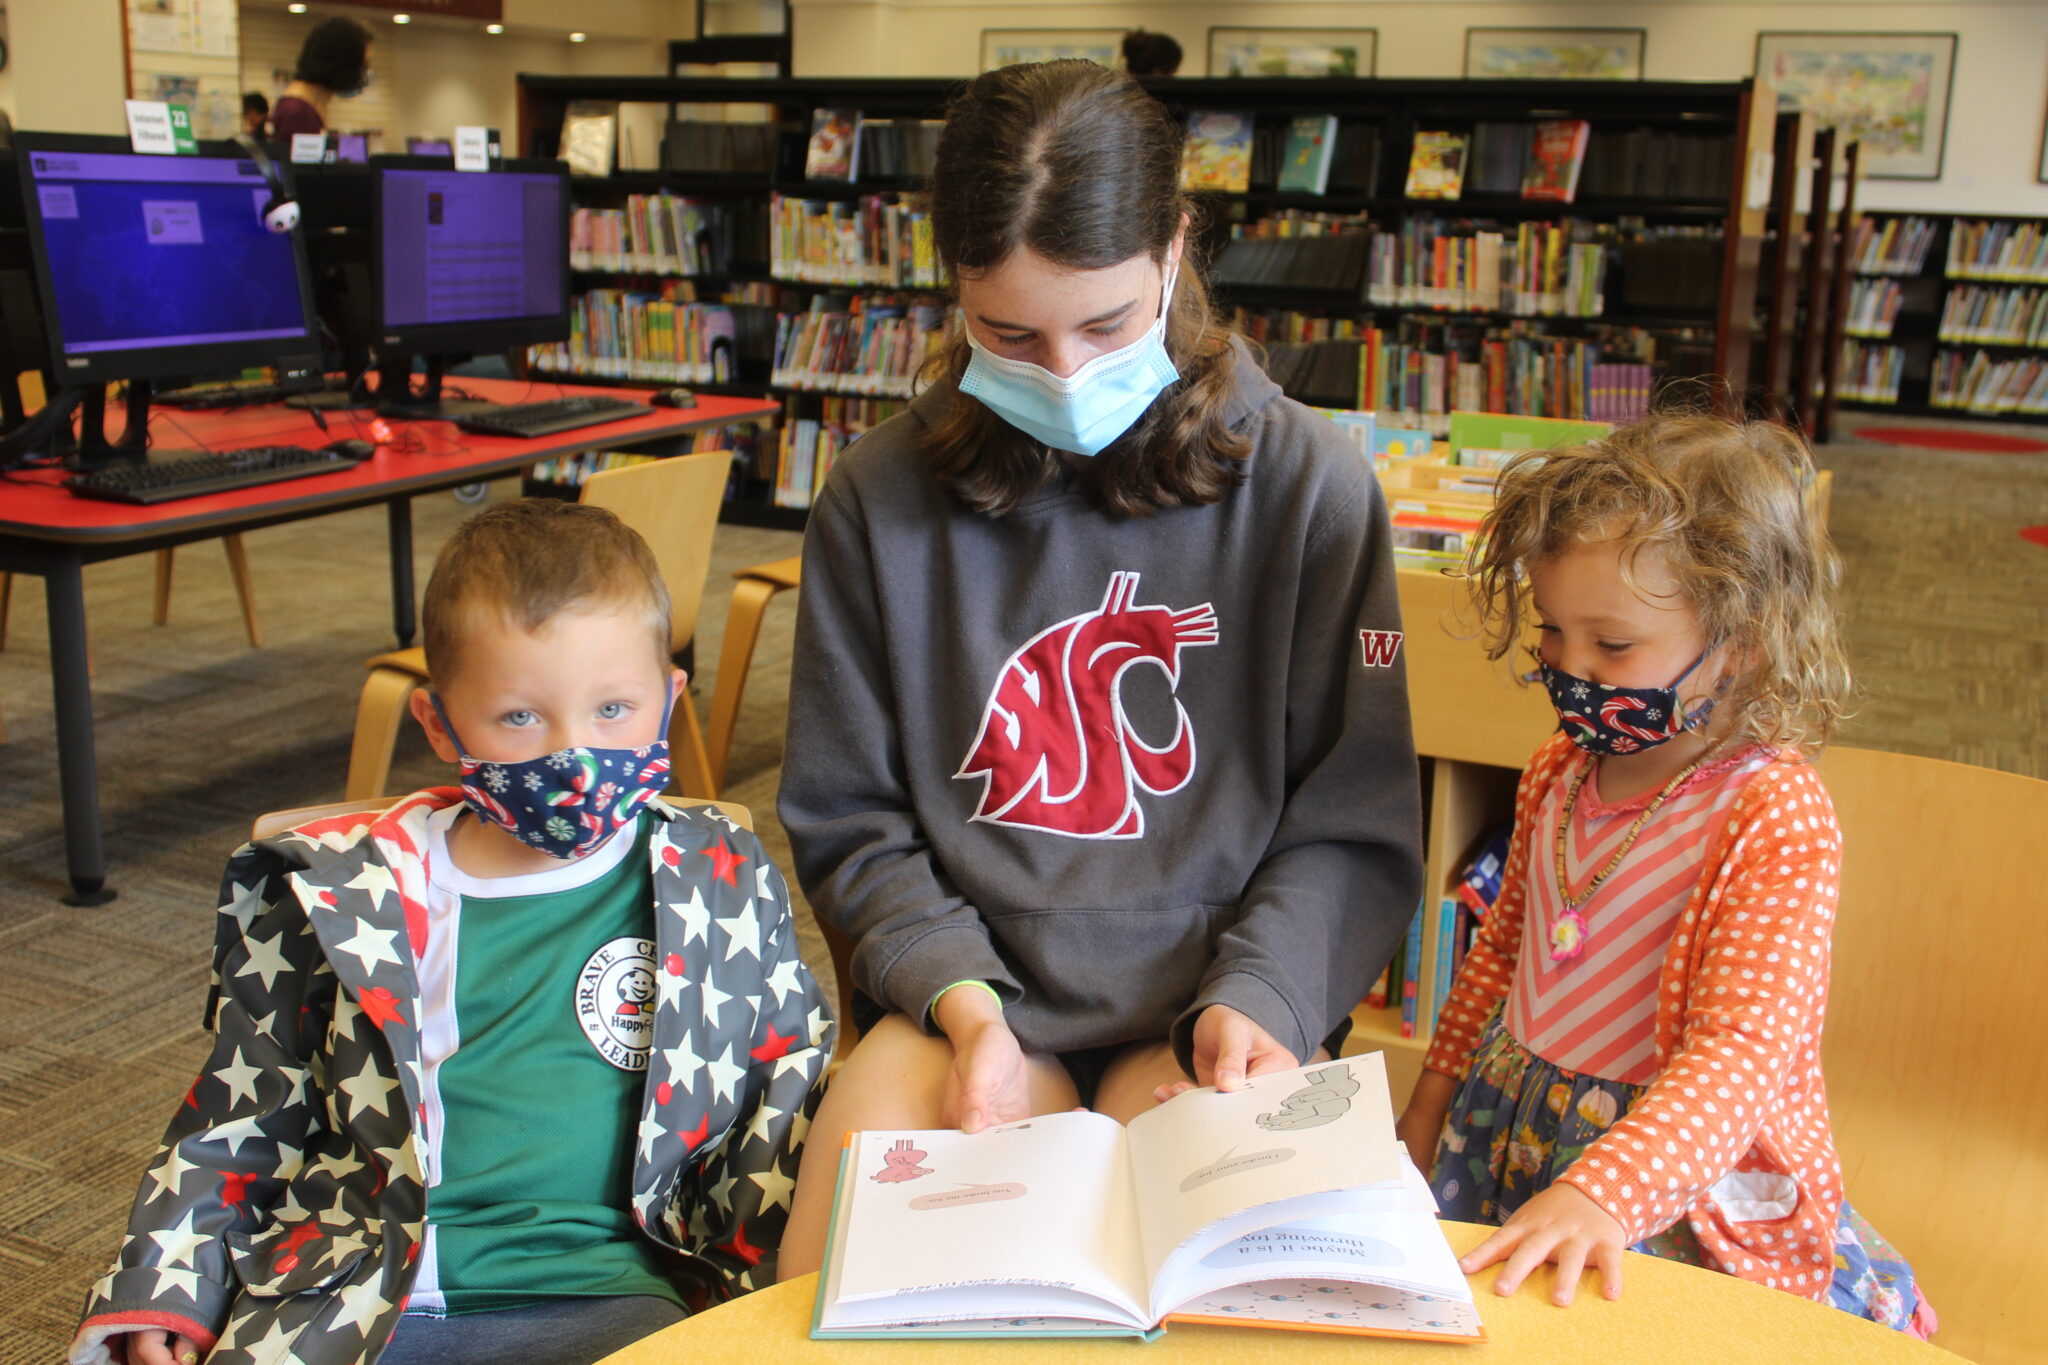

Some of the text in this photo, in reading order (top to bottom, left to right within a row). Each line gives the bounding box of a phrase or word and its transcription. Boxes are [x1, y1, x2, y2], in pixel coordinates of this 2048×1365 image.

[172, 110, 189, 128] 22
[1359, 628, 1404, 668] W
[580, 949, 615, 1016] BRAVE
[1240, 1231, 1365, 1247] throwing toy
[1239, 1244, 1366, 1257] Maybe it is a
